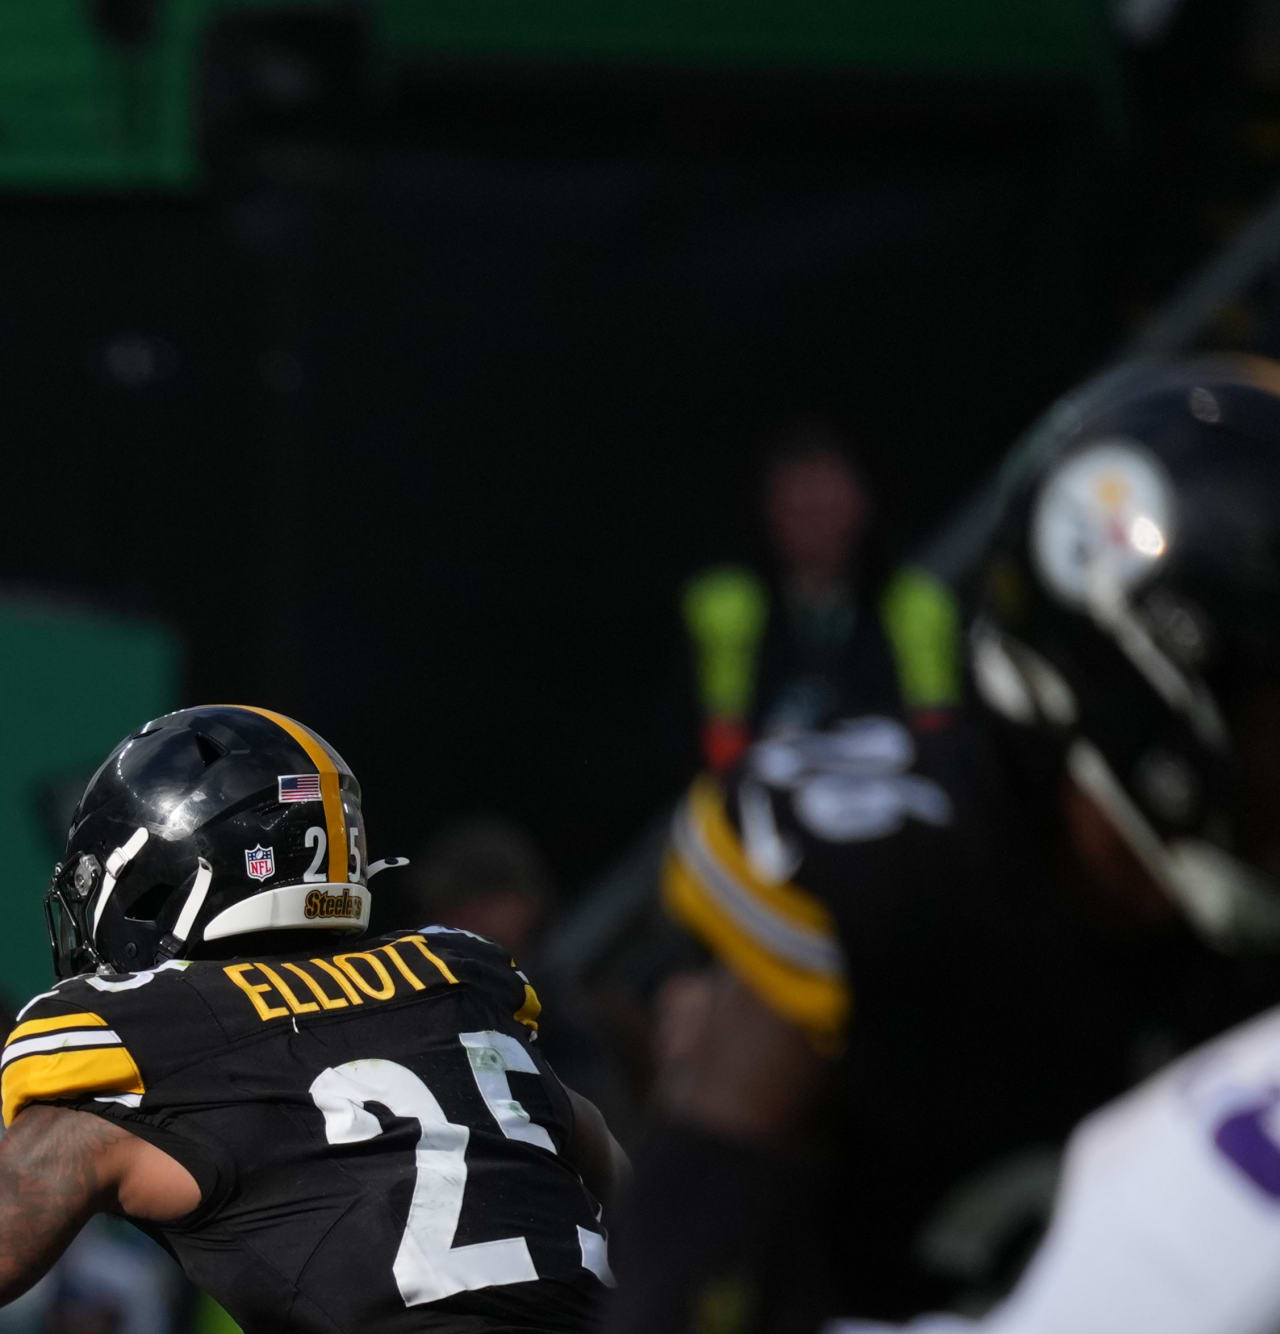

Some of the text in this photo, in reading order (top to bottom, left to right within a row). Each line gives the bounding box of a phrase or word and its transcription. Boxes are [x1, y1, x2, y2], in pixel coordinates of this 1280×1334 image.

[250, 860, 272, 876] NFL
[303, 826, 362, 883] 25
[304, 888, 362, 920] Steelers
[223, 935, 459, 1021] ELLIOTT
